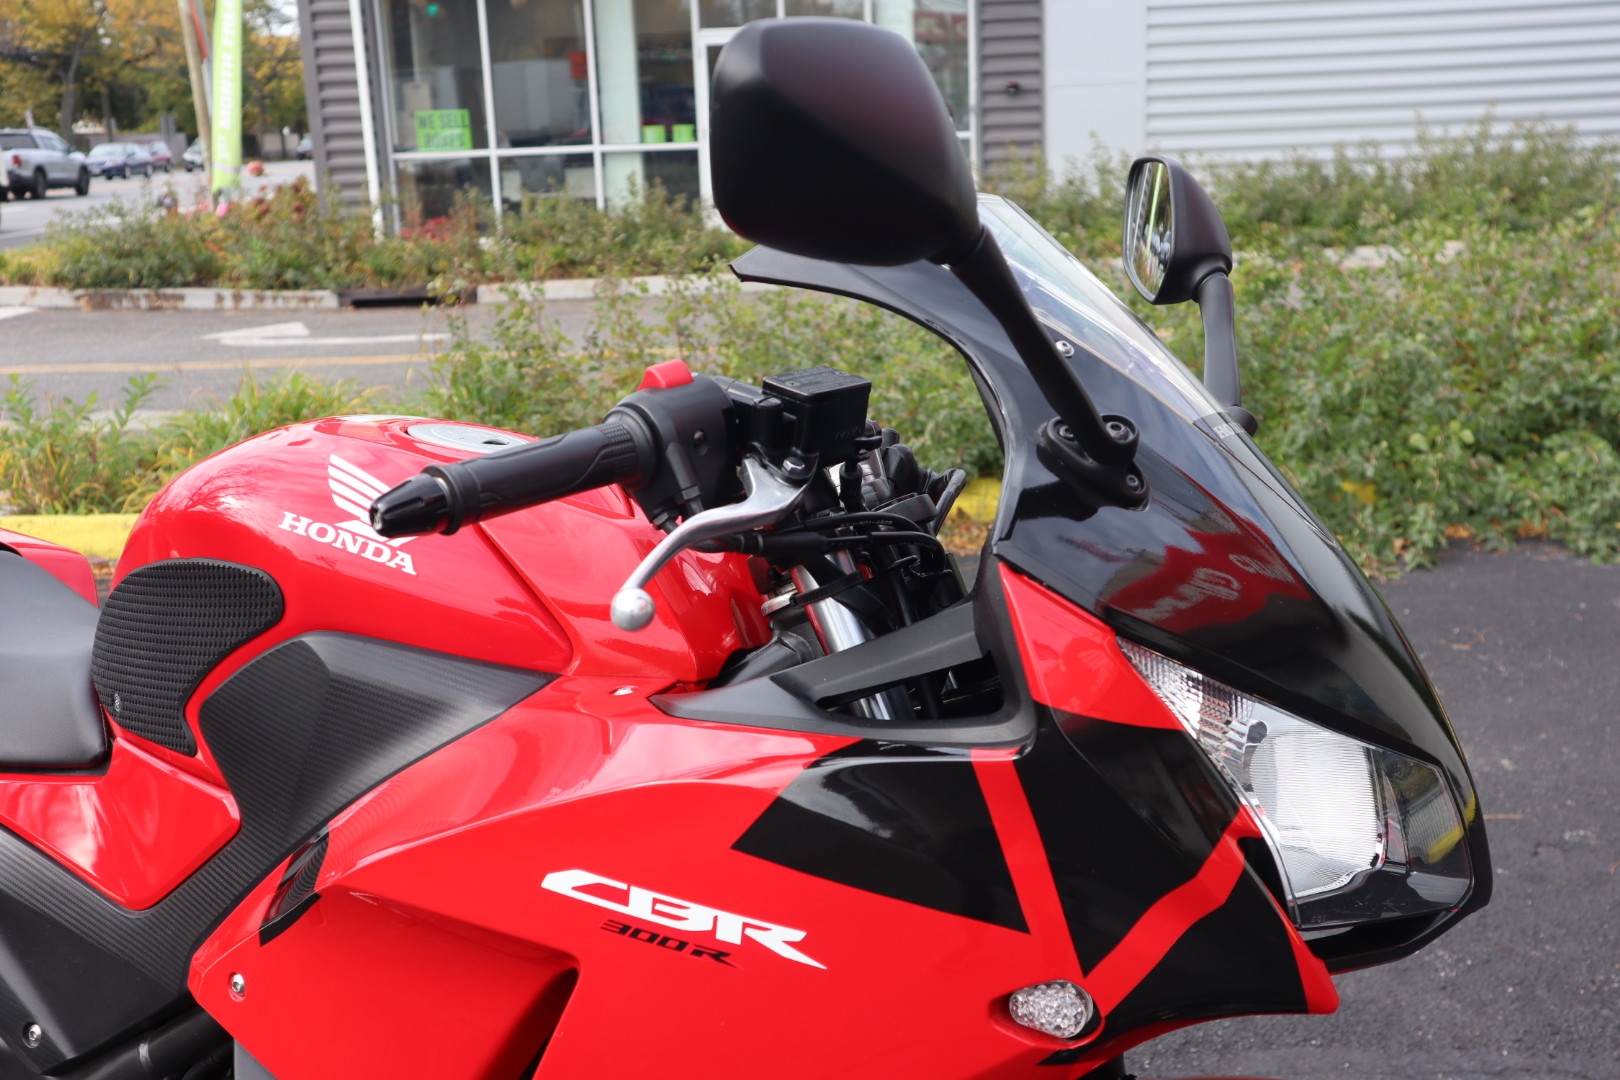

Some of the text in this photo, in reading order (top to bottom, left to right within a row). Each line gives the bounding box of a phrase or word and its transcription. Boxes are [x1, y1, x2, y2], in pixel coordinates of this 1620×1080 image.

[217, 53, 234, 130] MONTH
[278, 511, 417, 576] HONDA
[541, 869, 827, 970] CBR
